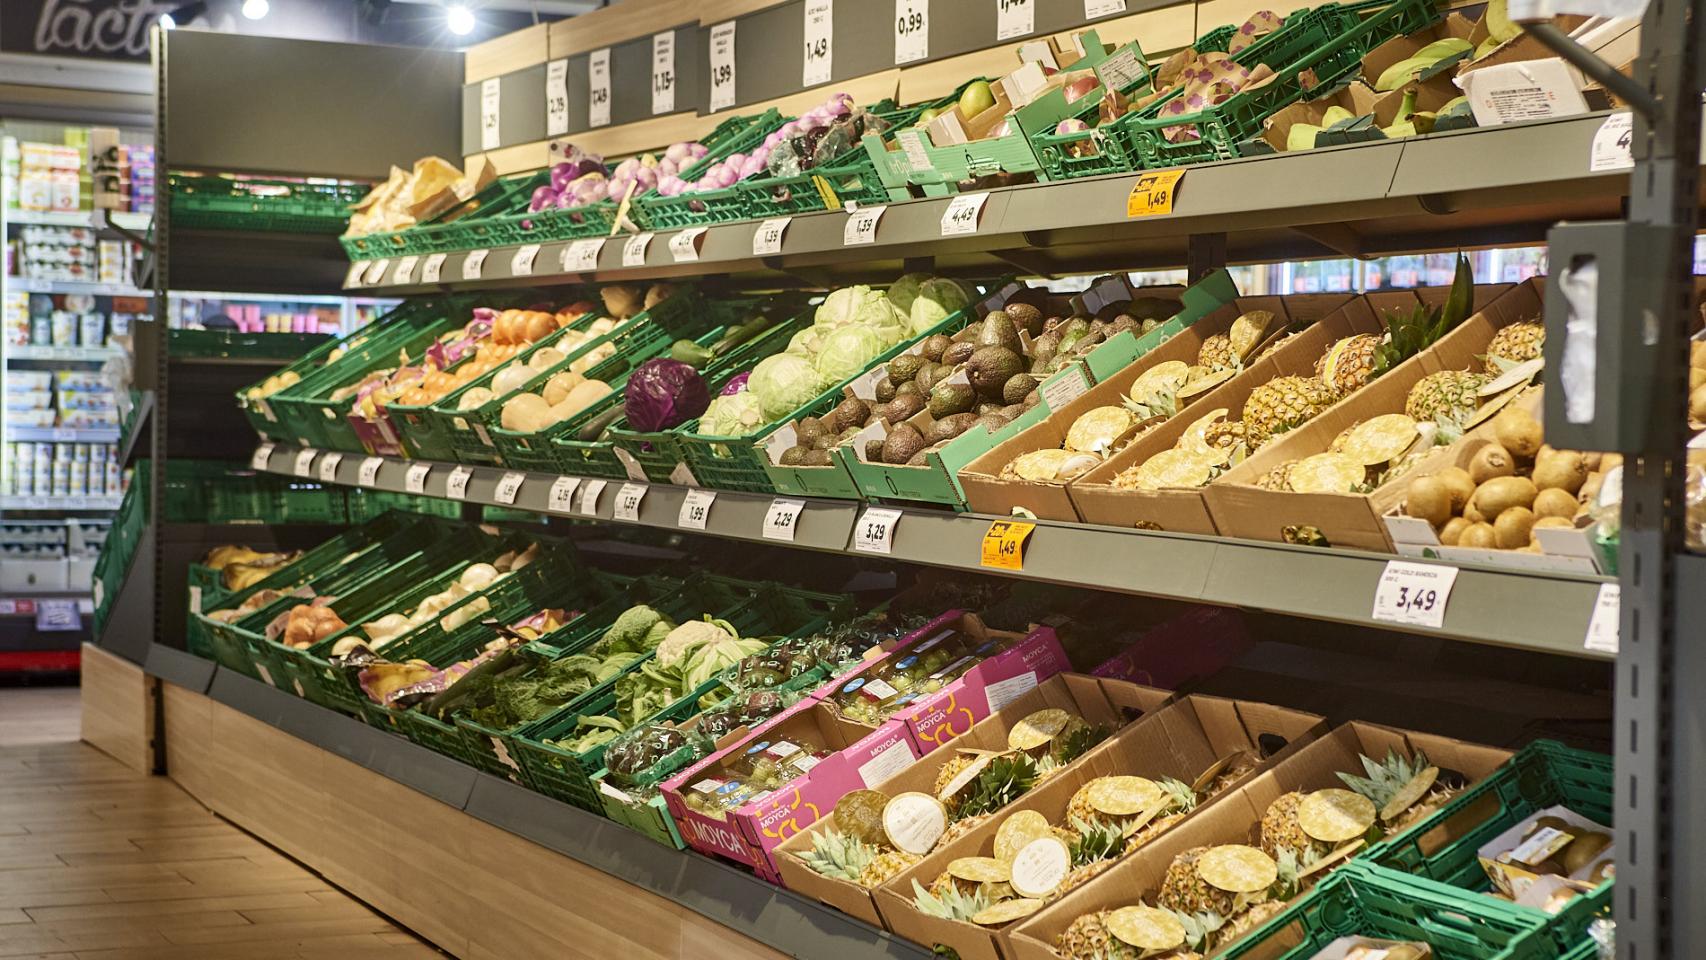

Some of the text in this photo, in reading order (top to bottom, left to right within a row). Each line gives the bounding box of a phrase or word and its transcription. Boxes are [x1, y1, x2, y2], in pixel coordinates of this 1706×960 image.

[898, 12, 922, 37] 0,99
[807, 38, 827, 63] 1,49
[1147, 190, 1167, 209] 1,49
[952, 206, 975, 225] 4,49
[856, 218, 873, 236] 1,39
[689, 505, 704, 523] 1,99
[774, 511, 793, 529] 2,29
[865, 522, 885, 542] 3,29
[998, 539, 1016, 557] 1,49
[1396, 586, 1437, 613] 3,49
[916, 709, 946, 733] MOYCA
[870, 736, 897, 757] MOYCA
[760, 807, 791, 830] MOYCA
[690, 819, 747, 857] MOYCA
